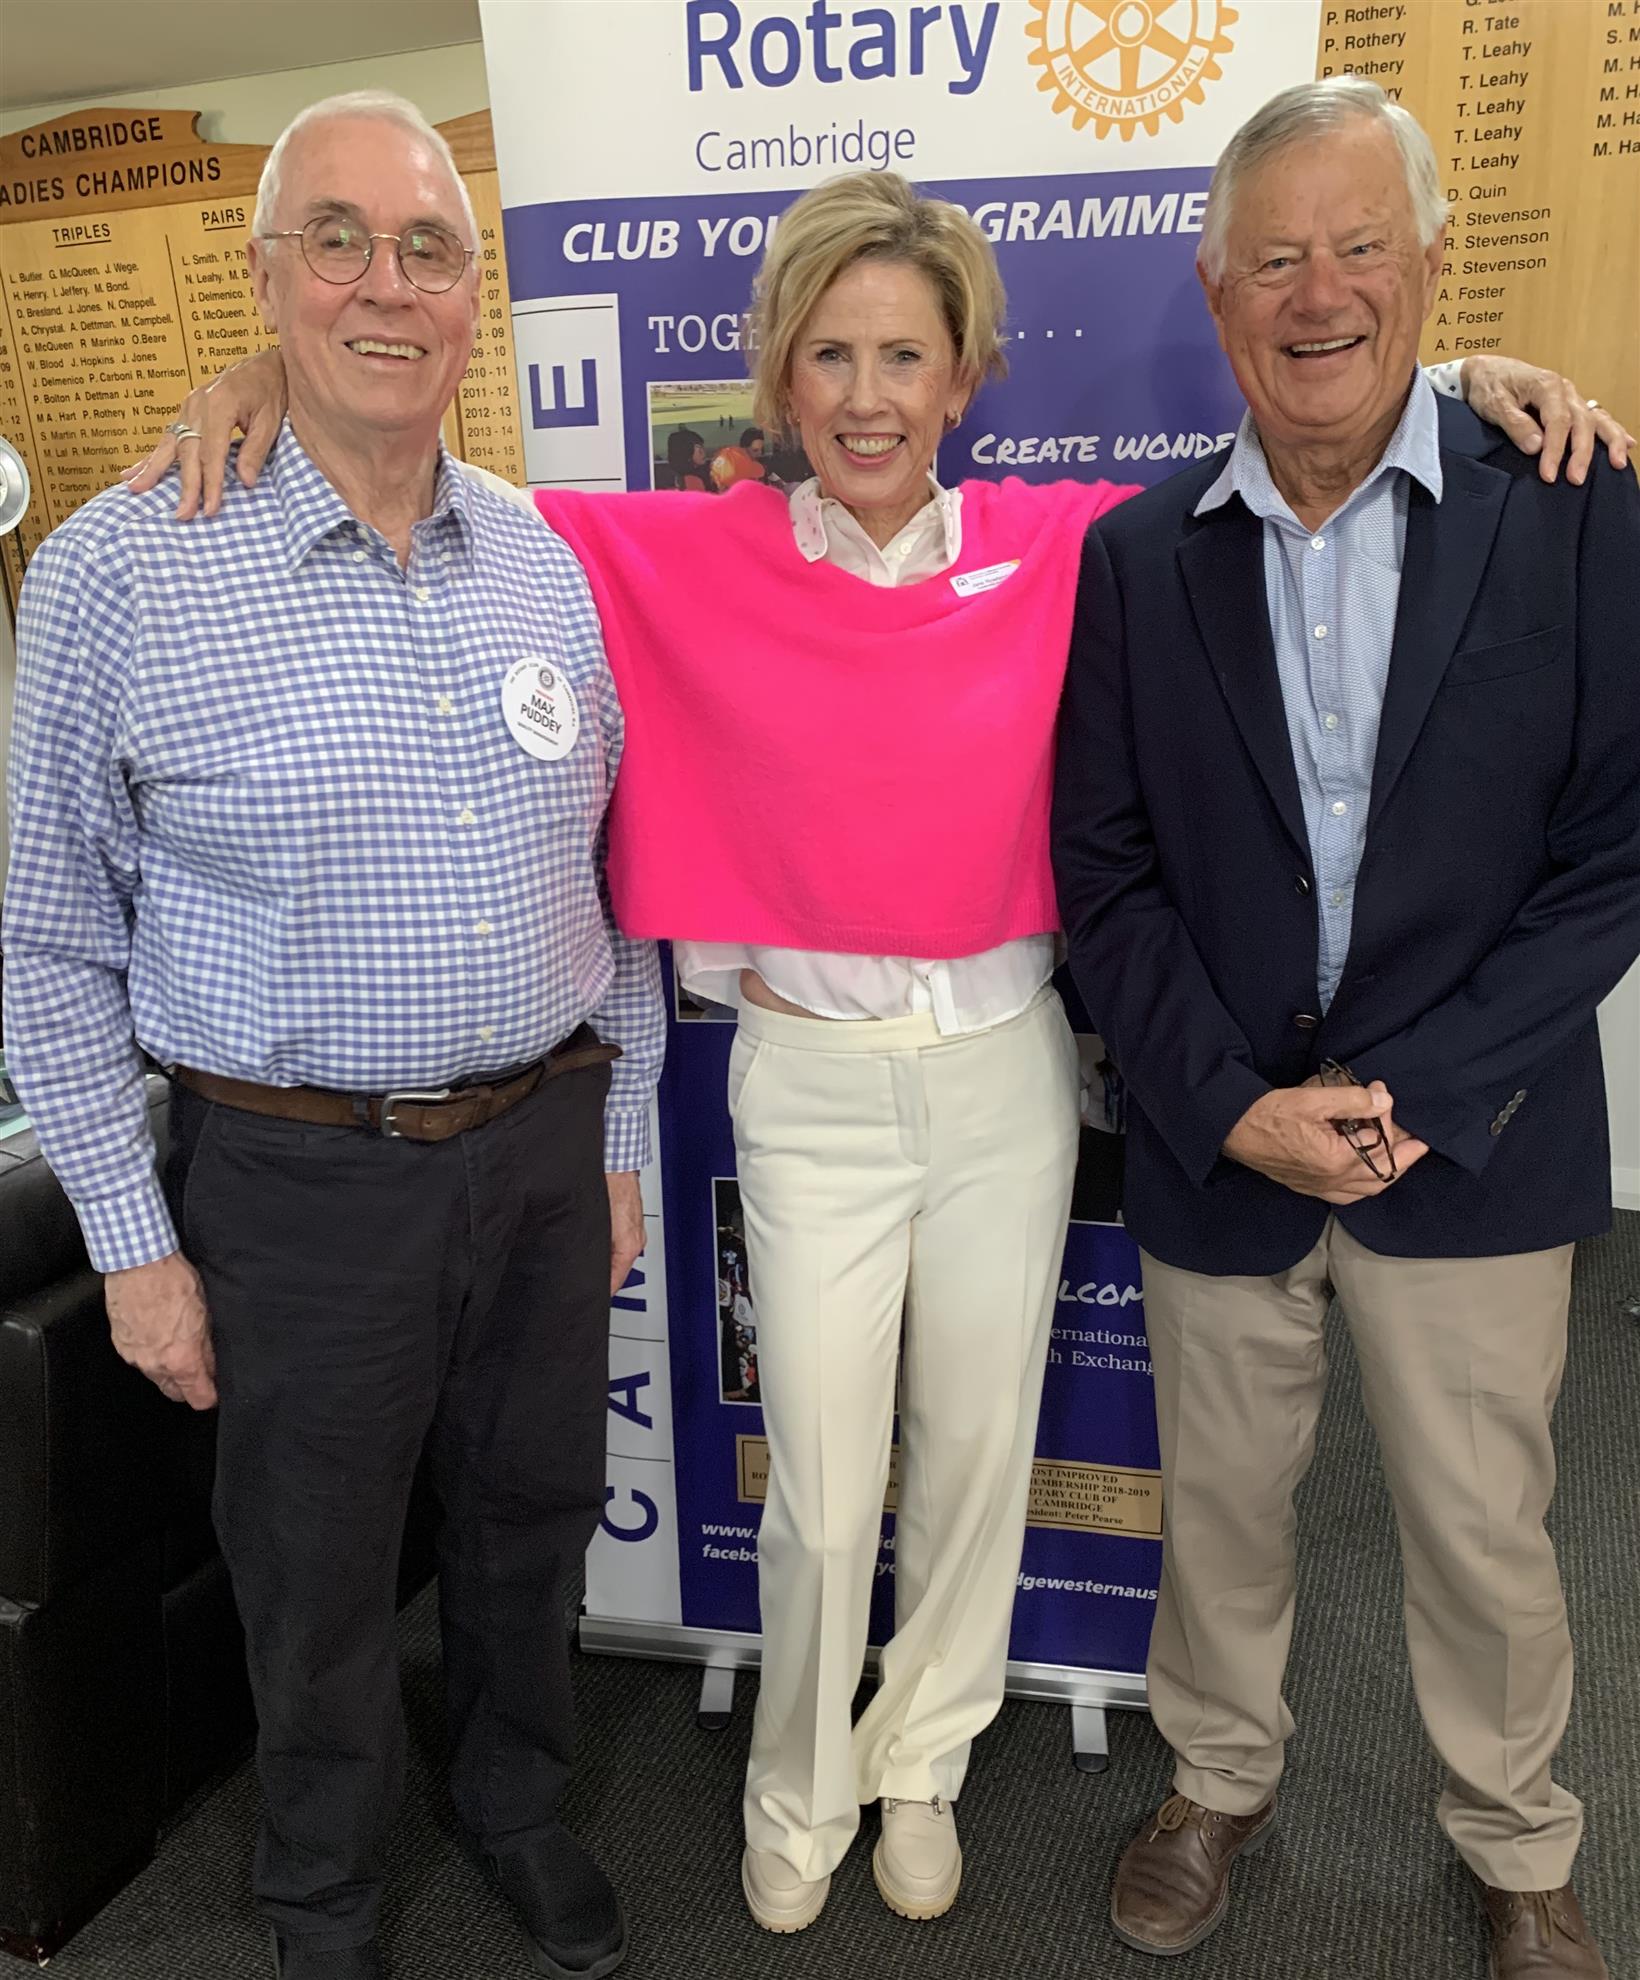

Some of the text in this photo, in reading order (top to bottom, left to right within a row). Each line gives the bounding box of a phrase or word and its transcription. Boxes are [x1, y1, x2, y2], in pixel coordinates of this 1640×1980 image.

[1327, 5, 1406, 25] P. Rothery.
[1462, 16, 1520, 35] R. Tate
[687, 0, 1000, 95] Rotary
[1325, 32, 1406, 52] P. Rothery
[1462, 40, 1532, 60] T. Leahy
[1058, 49, 1205, 118] INTERNATIONAL
[1460, 71, 1529, 89] T. Leahy
[1457, 98, 1525, 117] T. Leahy
[1597, 114, 1617, 128] M.
[21, 117, 163, 158] CAMBRIDGE
[1454, 125, 1523, 144] T. Leahy
[695, 119, 916, 171] Cambridge
[1593, 142, 1613, 156] M.
[1451, 153, 1520, 171] T. Leahy
[76, 157, 220, 196] CHAMPIONS
[1447, 185, 1507, 201] D. Quin
[52, 208, 245, 242] TRIPLES PAIRS
[1466, 207, 1551, 227] Stevenson
[562, 220, 678, 263] CLUB
[1443, 231, 1549, 250] R. Stevenson
[1442, 256, 1547, 276] R. Stevenson
[1438, 285, 1505, 301] A. Foster
[1437, 310, 1503, 326] A. Foster
[1435, 335, 1501, 351] A. Foster
[41, 360, 64, 369] Blood
[81, 357, 115, 368] Hopkins
[132, 353, 157, 362] Jones
[100, 370, 132, 382] Carboni
[148, 368, 185, 378] Morrison
[44, 394, 70, 404] Bolton
[134, 389, 154, 398] Lane
[59, 412, 76, 422] Hart
[94, 408, 125, 419] Rothery
[91, 428, 127, 437] Morrison
[971, 433, 1099, 465] CREATE
[531, 695, 555, 716] MAX
[521, 704, 562, 734] PUDDEY
[1057, 1470, 1117, 1483] IMPROVED
[1070, 1493, 1099, 1502] CLUB
[1102, 1486, 1150, 1496] 2018-2019
[1035, 1499, 1103, 1512] CAMBRIDGE
[1065, 1512, 1089, 1520] Peter
[1093, 1516, 1123, 1524] Pearse
